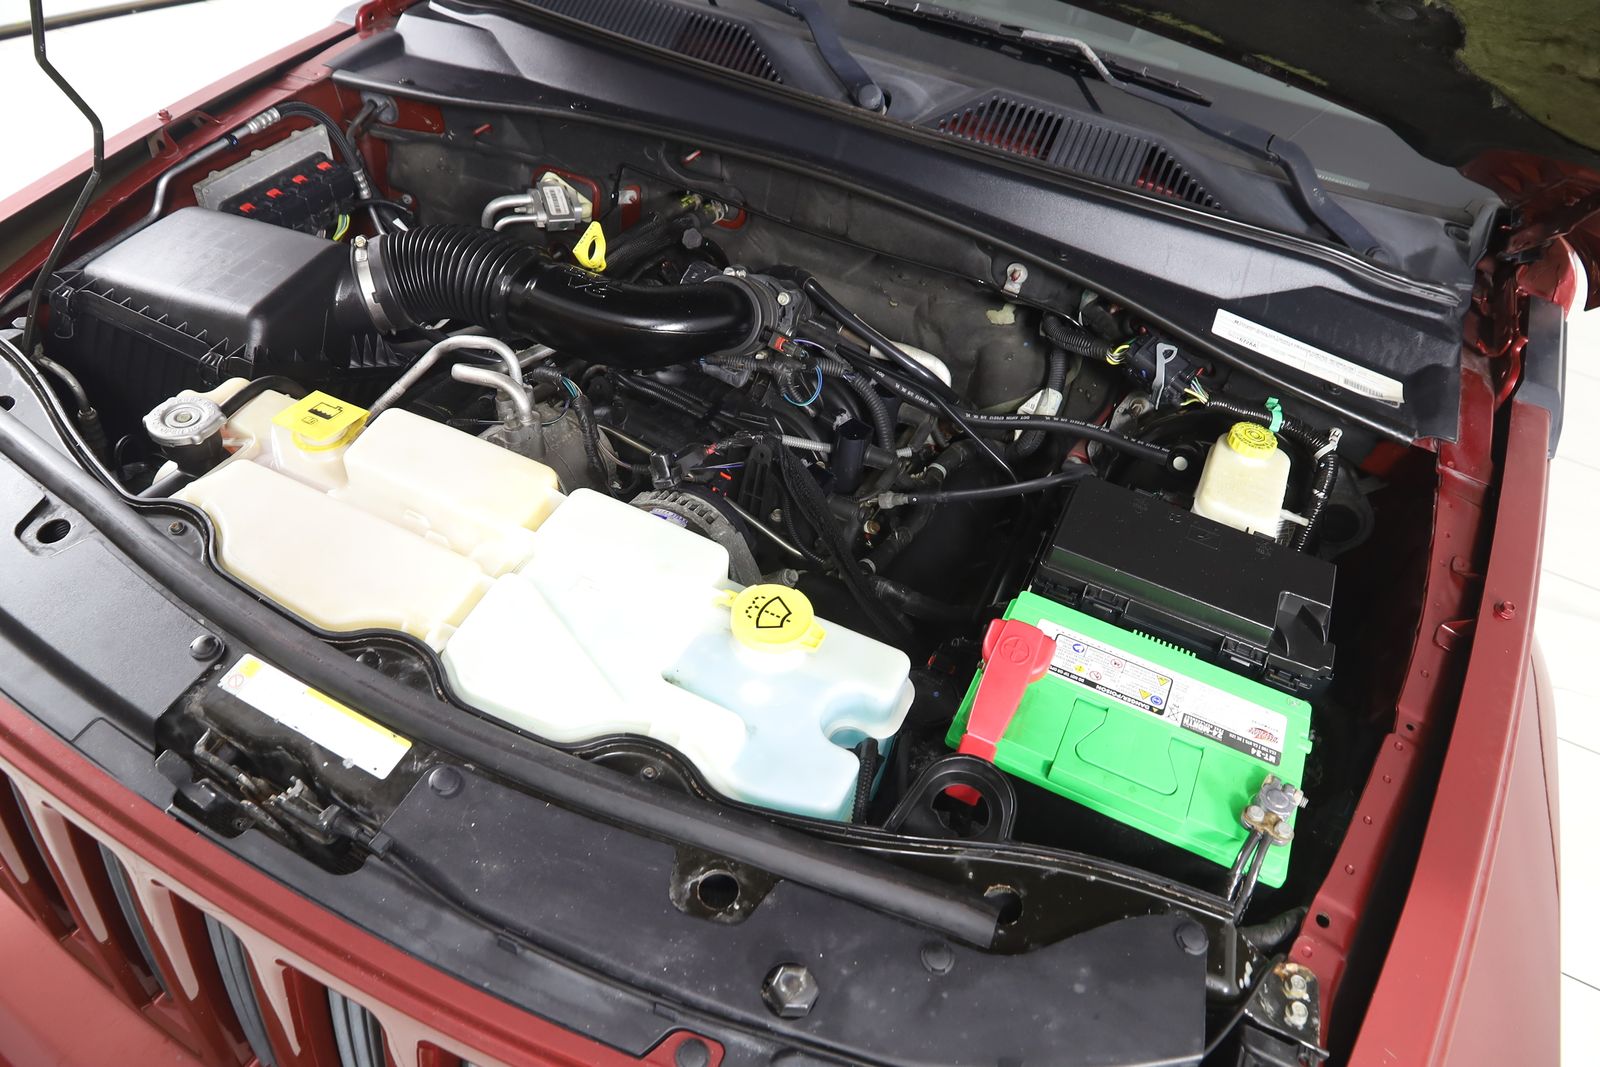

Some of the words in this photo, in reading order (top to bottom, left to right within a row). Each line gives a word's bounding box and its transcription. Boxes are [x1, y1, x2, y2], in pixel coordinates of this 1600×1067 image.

[1095, 685, 1150, 709] DANGER/POISON
[1182, 718, 1225, 739] 24-MONTH
[1249, 747, 1277, 763] MT-34
